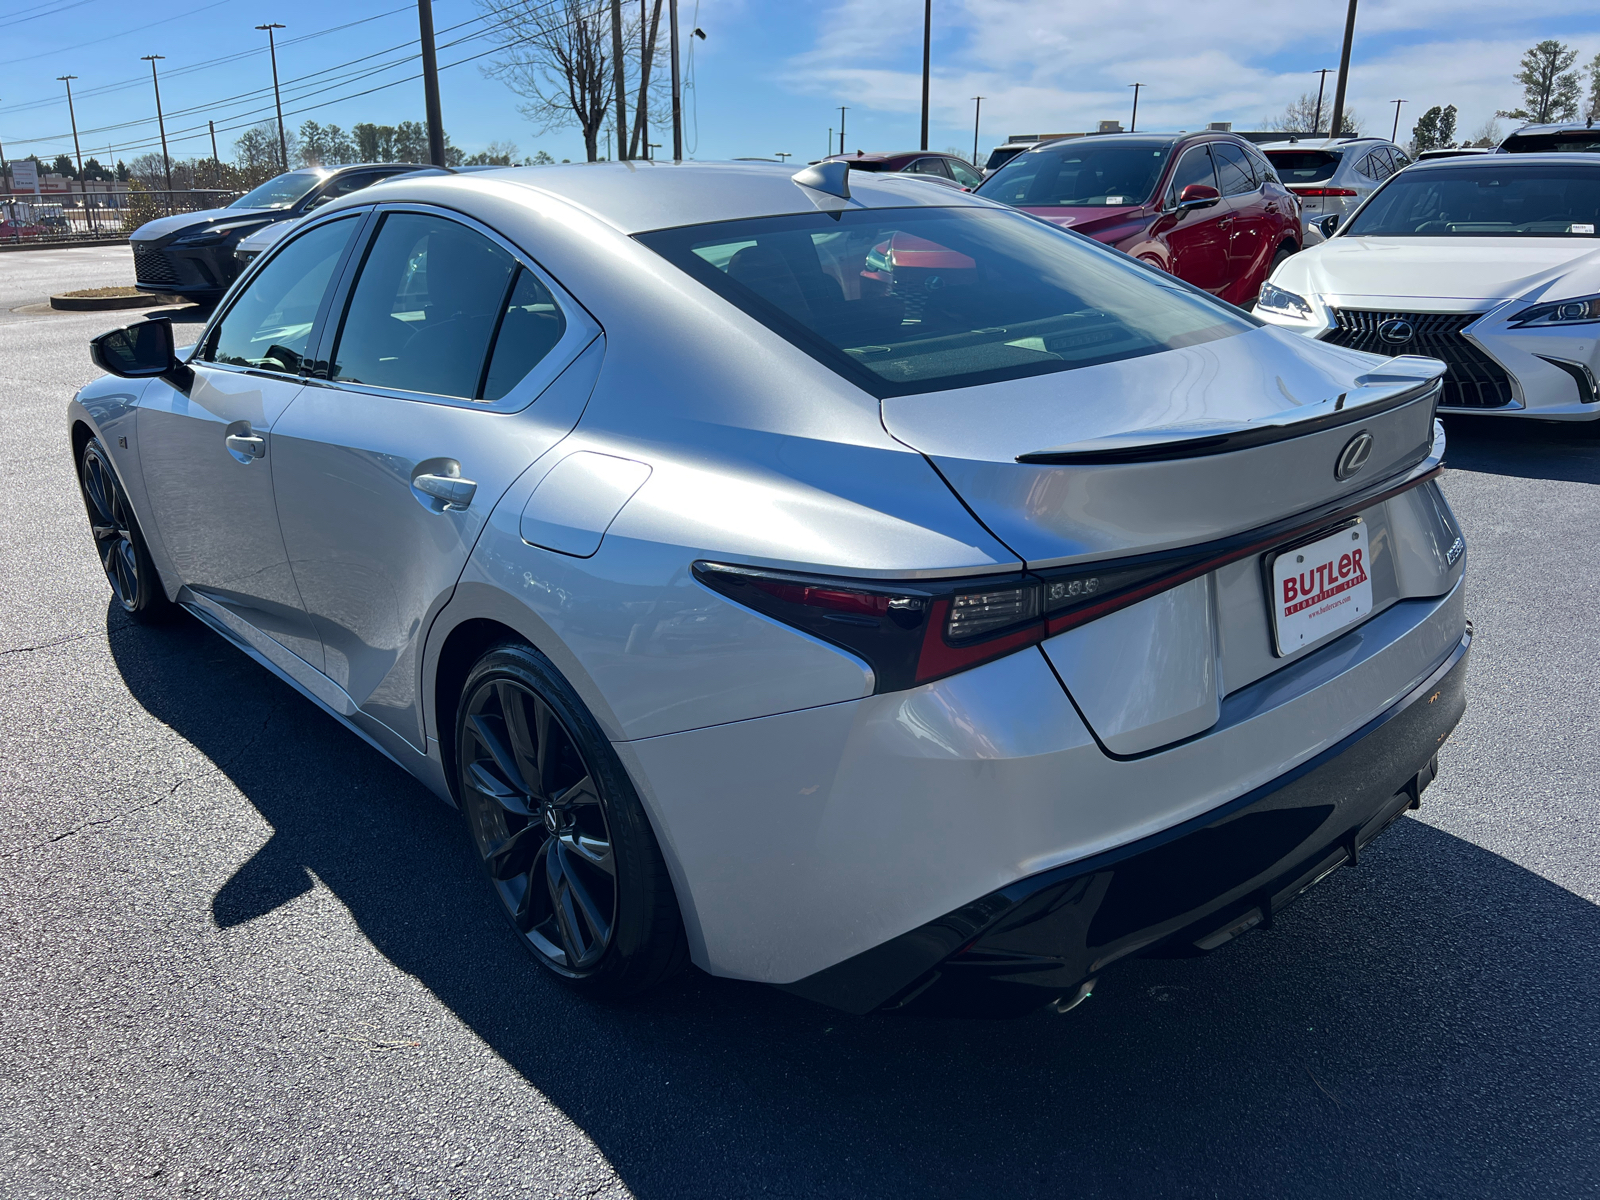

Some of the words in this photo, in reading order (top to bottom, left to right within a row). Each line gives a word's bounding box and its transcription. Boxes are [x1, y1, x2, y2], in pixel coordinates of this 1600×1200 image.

[1285, 587, 1337, 616] AUTOMOTIVE
[1343, 573, 1366, 589] GROUP
[1308, 595, 1352, 619] www.butlercars.com
